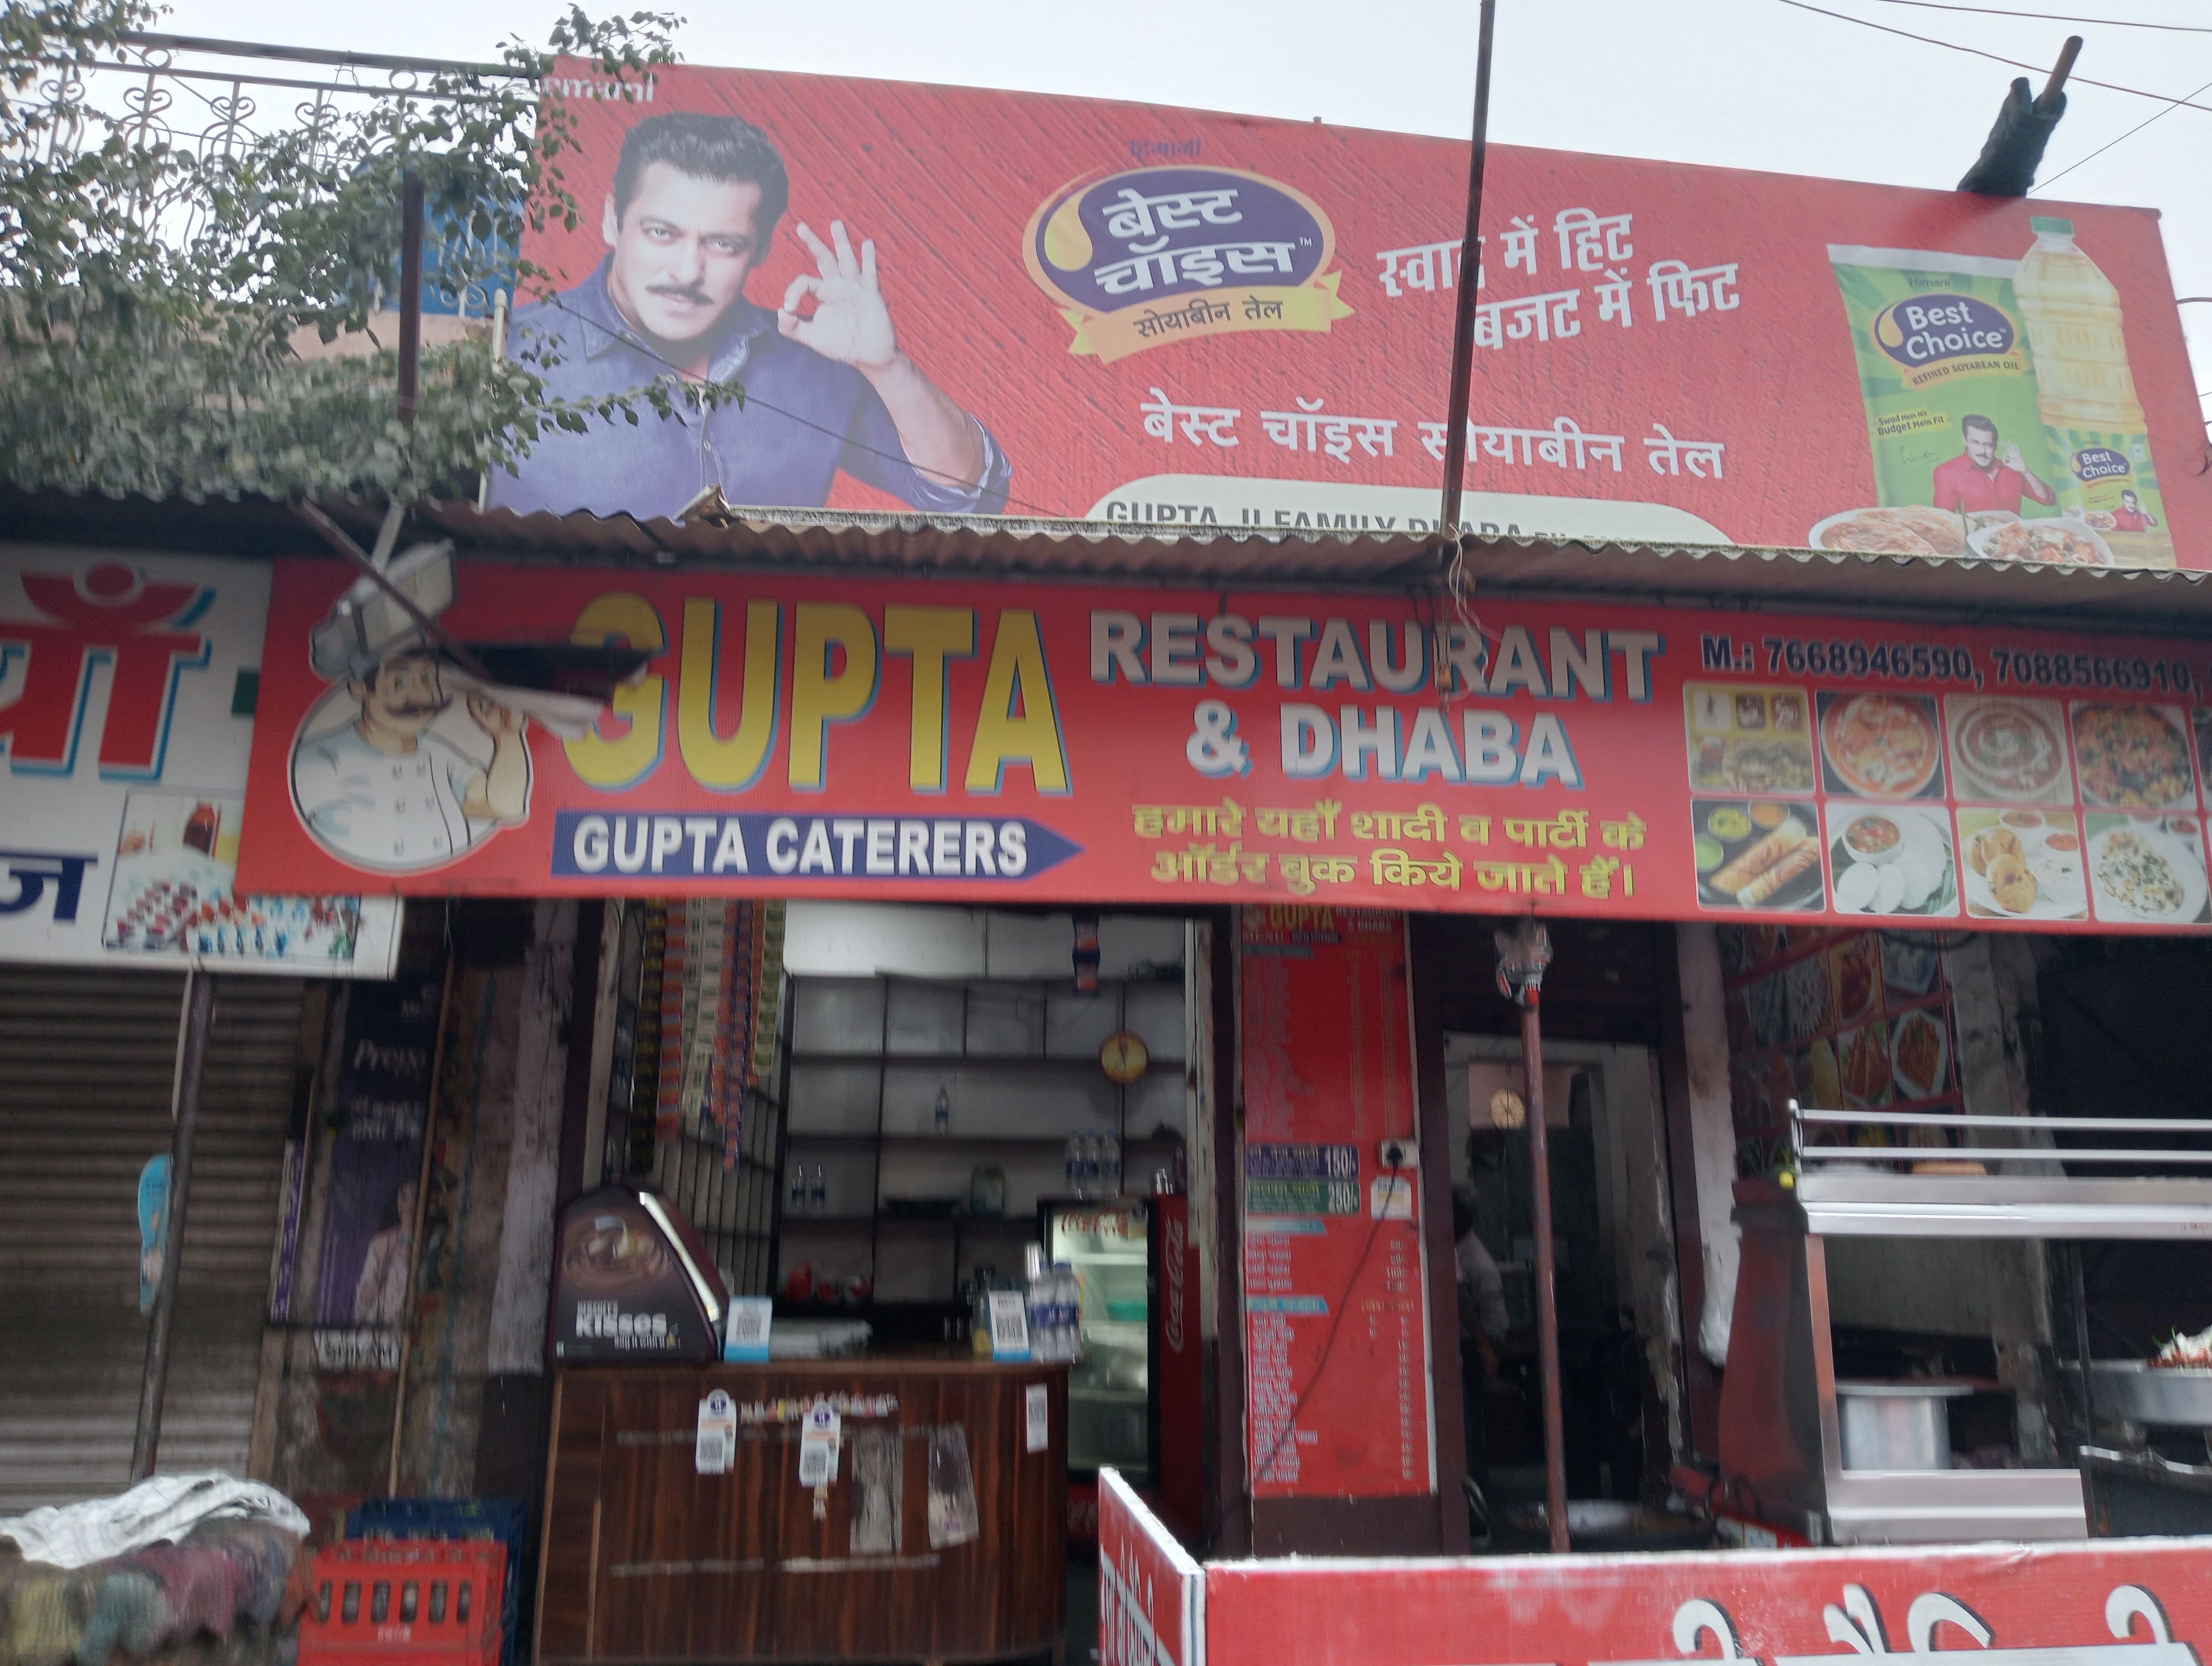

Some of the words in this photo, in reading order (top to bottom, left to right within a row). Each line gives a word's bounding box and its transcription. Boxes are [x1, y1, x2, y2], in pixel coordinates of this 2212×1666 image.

[1102, 187, 1243, 239] बेस्ट
[1094, 234, 1295, 295] चॉइस
[1500, 214, 1539, 275] में
[1553, 207, 1633, 271] हिट
[1133, 298, 1231, 338] सोयाबीन
[1242, 295, 1283, 320] तेल
[1472, 289, 1580, 350] बजट
[1594, 267, 1632, 328] में
[1646, 259, 1740, 322] फिट
[1905, 301, 1973, 331] Best
[1906, 326, 2004, 360] Choice
[1912, 367, 1950, 386] REFINED
[1951, 360, 2001, 373] SOYABEAN
[2003, 361, 2019, 370] OIL
[1140, 386, 1241, 447] बेस्ट
[1260, 396, 1398, 465] चॉइस
[1643, 422, 1726, 478] तेल
[1877, 421, 1912, 435] Budget
[2081, 451, 2112, 465] Best
[2082, 462, 2126, 479] Choice
[1089, 608, 1666, 702] RESTAURANT
[562, 591, 1073, 797] GUPTA
[1185, 699, 1253, 779] &
[1279, 702, 1586, 790] DHABA
[573, 814, 750, 875] GUPTA
[764, 816, 1028, 877] CATERERS
[1131, 797, 1246, 838] हमारे
[1254, 798, 1342, 843] यहाँ
[1349, 802, 1448, 842] शादी
[1458, 814, 1493, 846] व
[1502, 808, 1590, 850] पार्टी
[1599, 811, 1648, 850] के
[1150, 841, 1270, 886] ऑर्डर
[1277, 853, 1359, 895] बुक
[1369, 847, 1464, 892] किये
[1472, 853, 1569, 895] जाते
